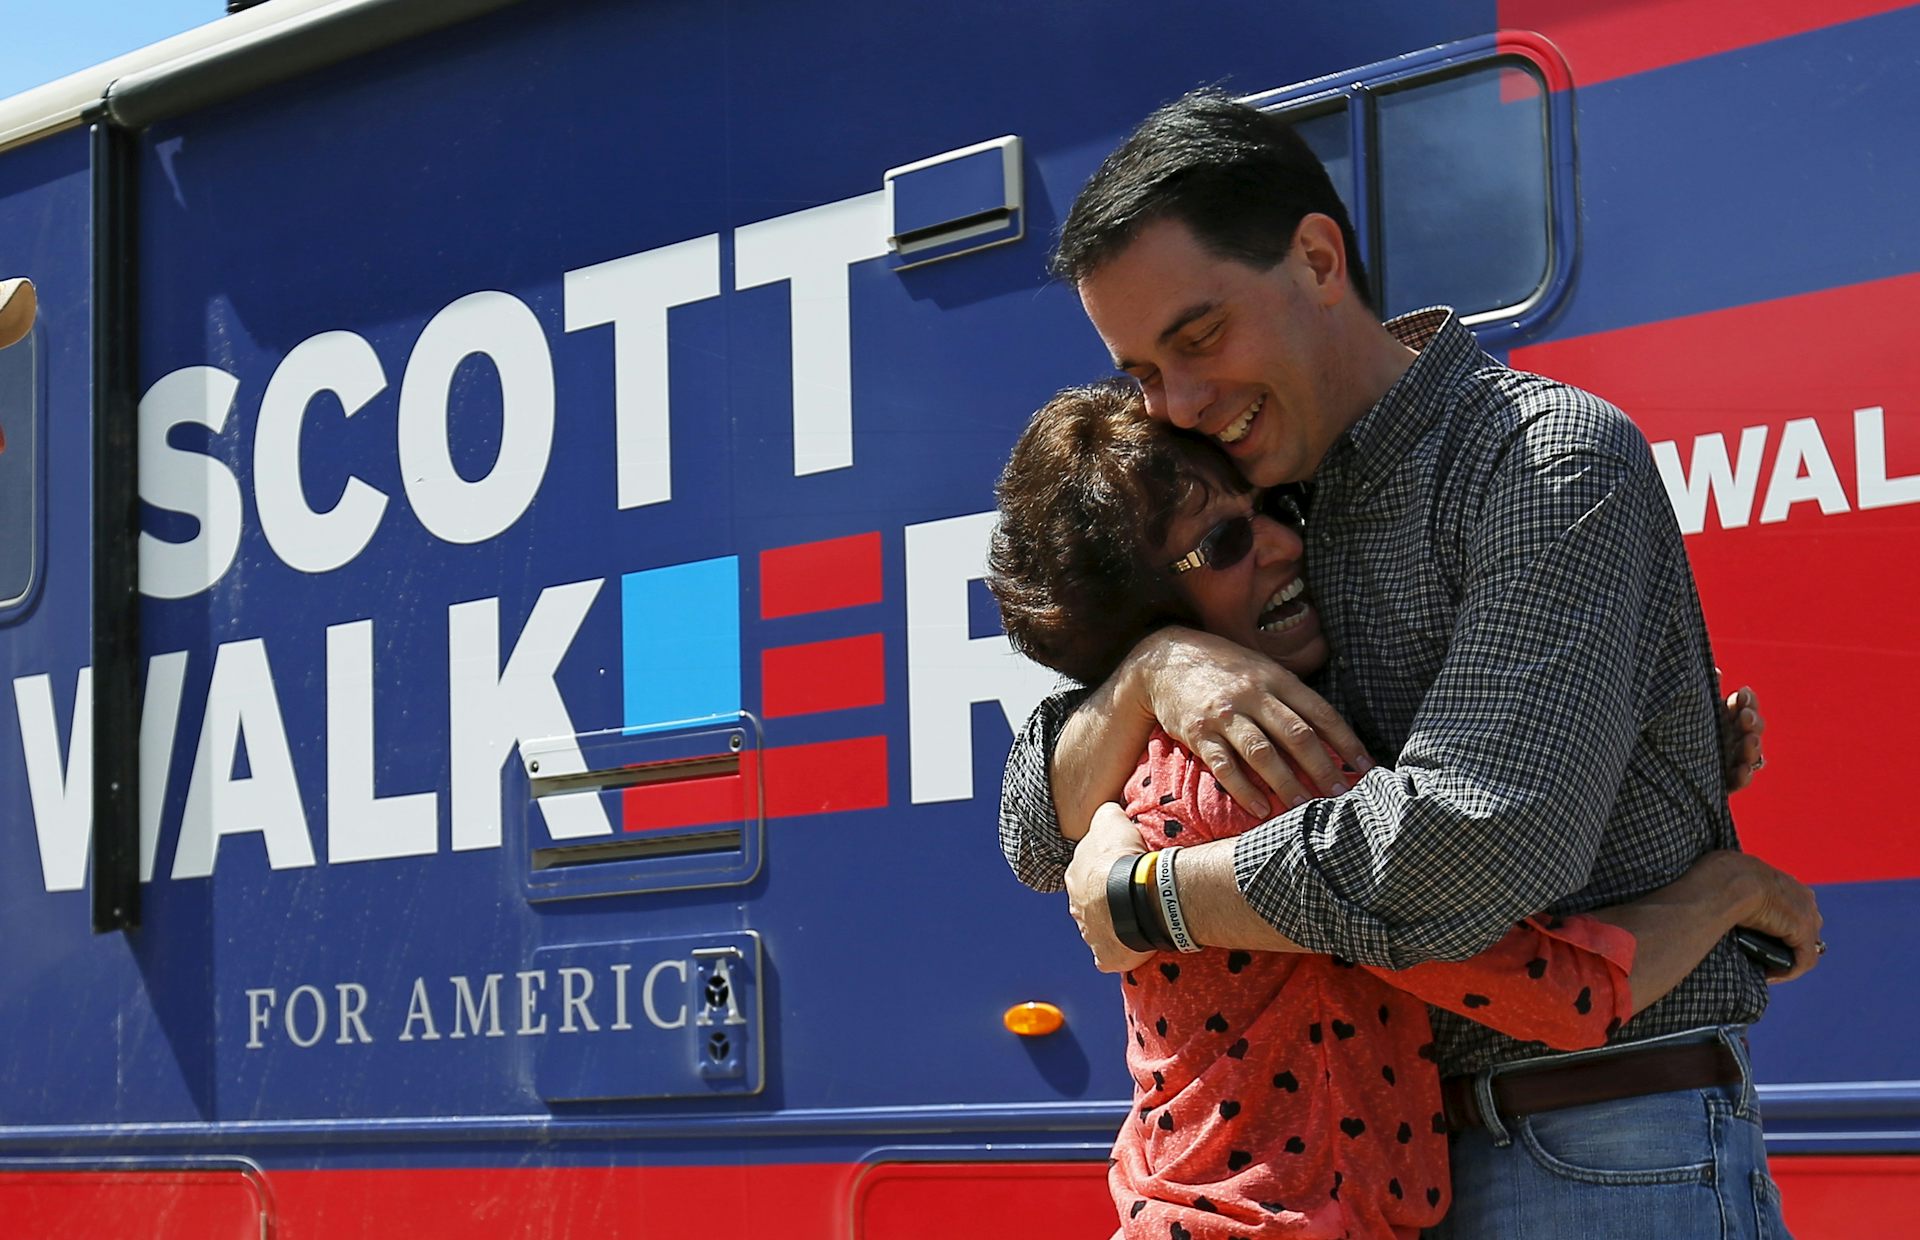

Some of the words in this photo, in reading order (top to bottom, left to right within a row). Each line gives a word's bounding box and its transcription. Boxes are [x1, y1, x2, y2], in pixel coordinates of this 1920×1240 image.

[138, 189, 888, 599] SCOTT
[1650, 406, 1920, 536] WAL
[1162, 886, 1173, 898] D.
[1166, 899, 1183, 932] Jeremy
[1174, 932, 1190, 948] SSG
[246, 983, 373, 1050] FOR
[399, 957, 747, 1042] AMERICA
